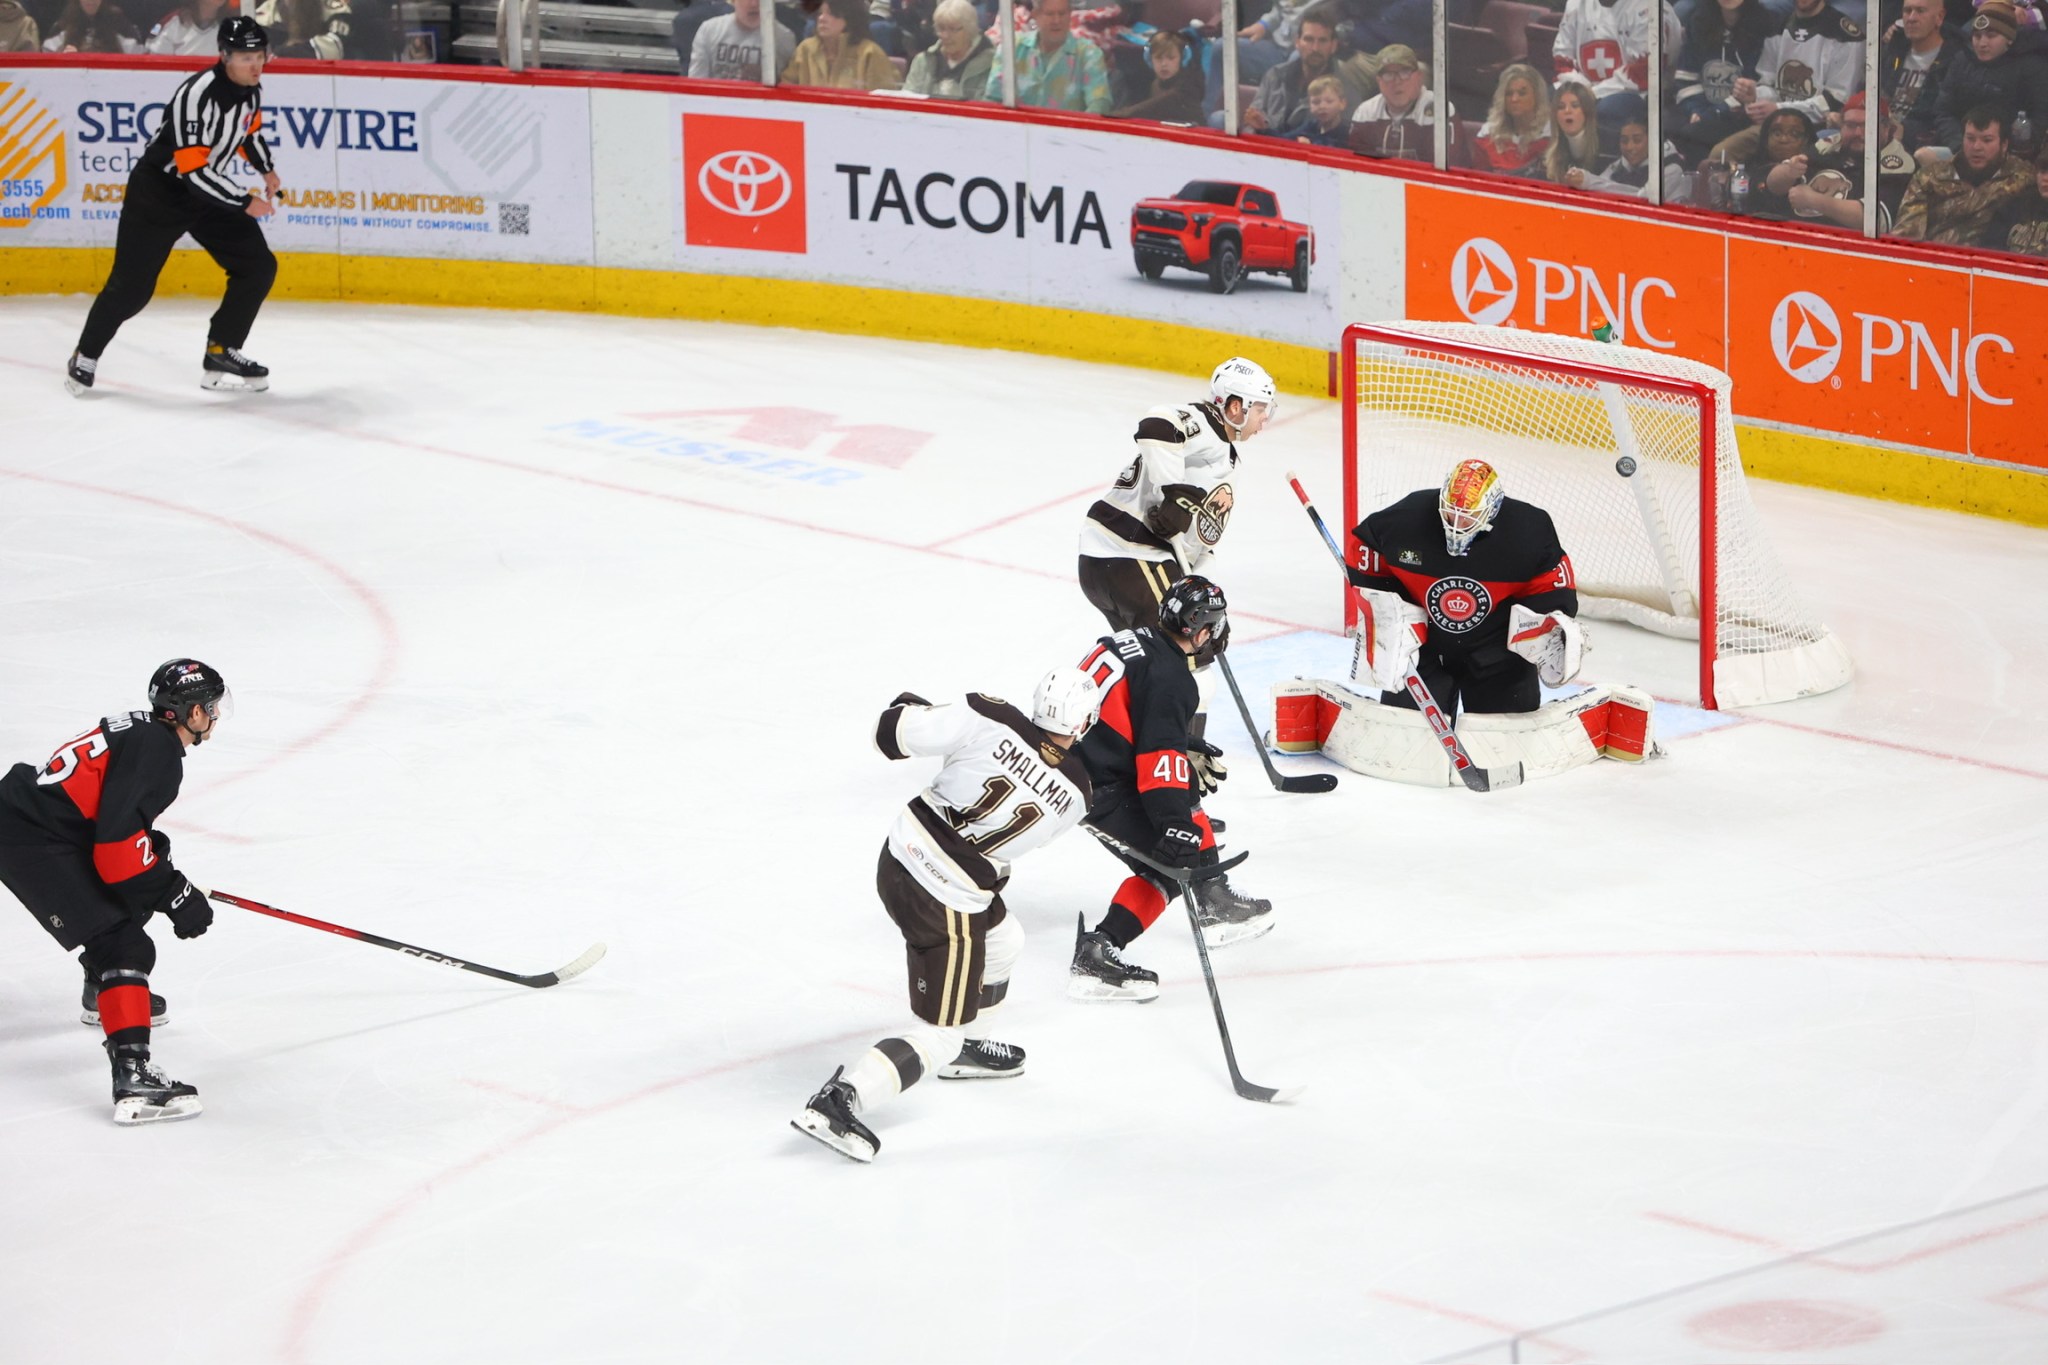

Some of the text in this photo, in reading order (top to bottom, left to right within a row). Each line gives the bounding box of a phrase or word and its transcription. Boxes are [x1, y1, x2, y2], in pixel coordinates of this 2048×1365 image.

[78, 101, 418, 152] SECEWIRE
[186, 122, 199, 133] 47
[2, 180, 44, 197] 3555
[278, 190, 355, 211] ALARMS
[0, 203, 70, 219] ech.com
[371, 193, 485, 215] MONITORING
[836, 164, 1112, 250] TACOMA
[288, 214, 357, 226] PROTECTING
[362, 218, 412, 229] WITHOUT
[1527, 257, 1677, 349] PNC
[1853, 312, 2014, 406] PNC
[1176, 408, 1202, 439] 43
[1357, 544, 1380, 573] 31
[1552, 560, 1572, 588] 31
[1431, 580, 1488, 604] CHARLOTTE
[1430, 605, 1485, 631] CHECKERS
[1046, 704, 1057, 719] 11
[1406, 675, 1471, 771] CCM
[992, 738, 1076, 817] SMALLMAN
[1153, 753, 1190, 784] 40
[1165, 827, 1203, 847] CCM
[924, 862, 949, 884] CCM
[171, 880, 193, 910] CC
[400, 946, 465, 970] CCM
